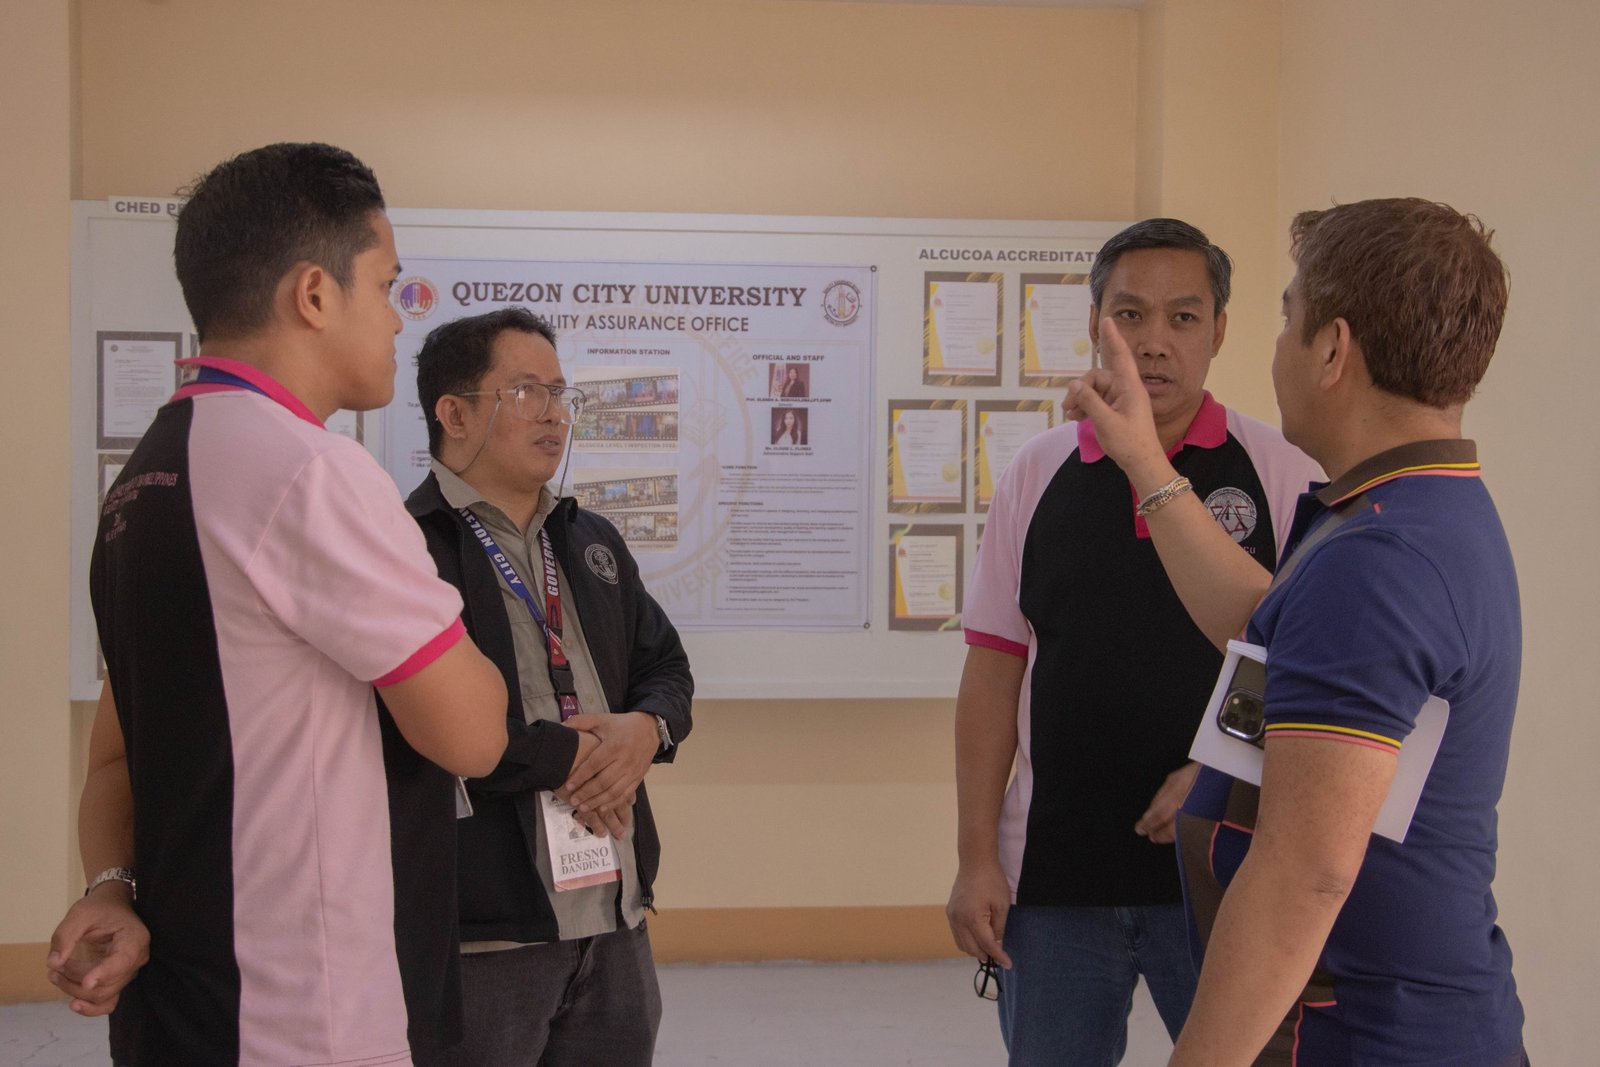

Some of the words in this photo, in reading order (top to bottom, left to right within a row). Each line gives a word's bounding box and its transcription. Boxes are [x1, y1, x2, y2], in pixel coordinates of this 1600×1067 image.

[115, 201, 161, 214] CHED
[918, 248, 993, 261] ALCUCOA
[995, 249, 1098, 262] ACCREDITAT
[452, 281, 564, 306] QUEZON
[572, 283, 636, 304] CITY
[644, 285, 807, 307] UNIVERSITY
[585, 315, 686, 331] ASSURANCE
[691, 316, 749, 332] OFFICE
[494, 552, 523, 585] CITY
[560, 846, 609, 865] FRESNO
[562, 859, 599, 875] DANDIN
[602, 858, 611, 867] L.
